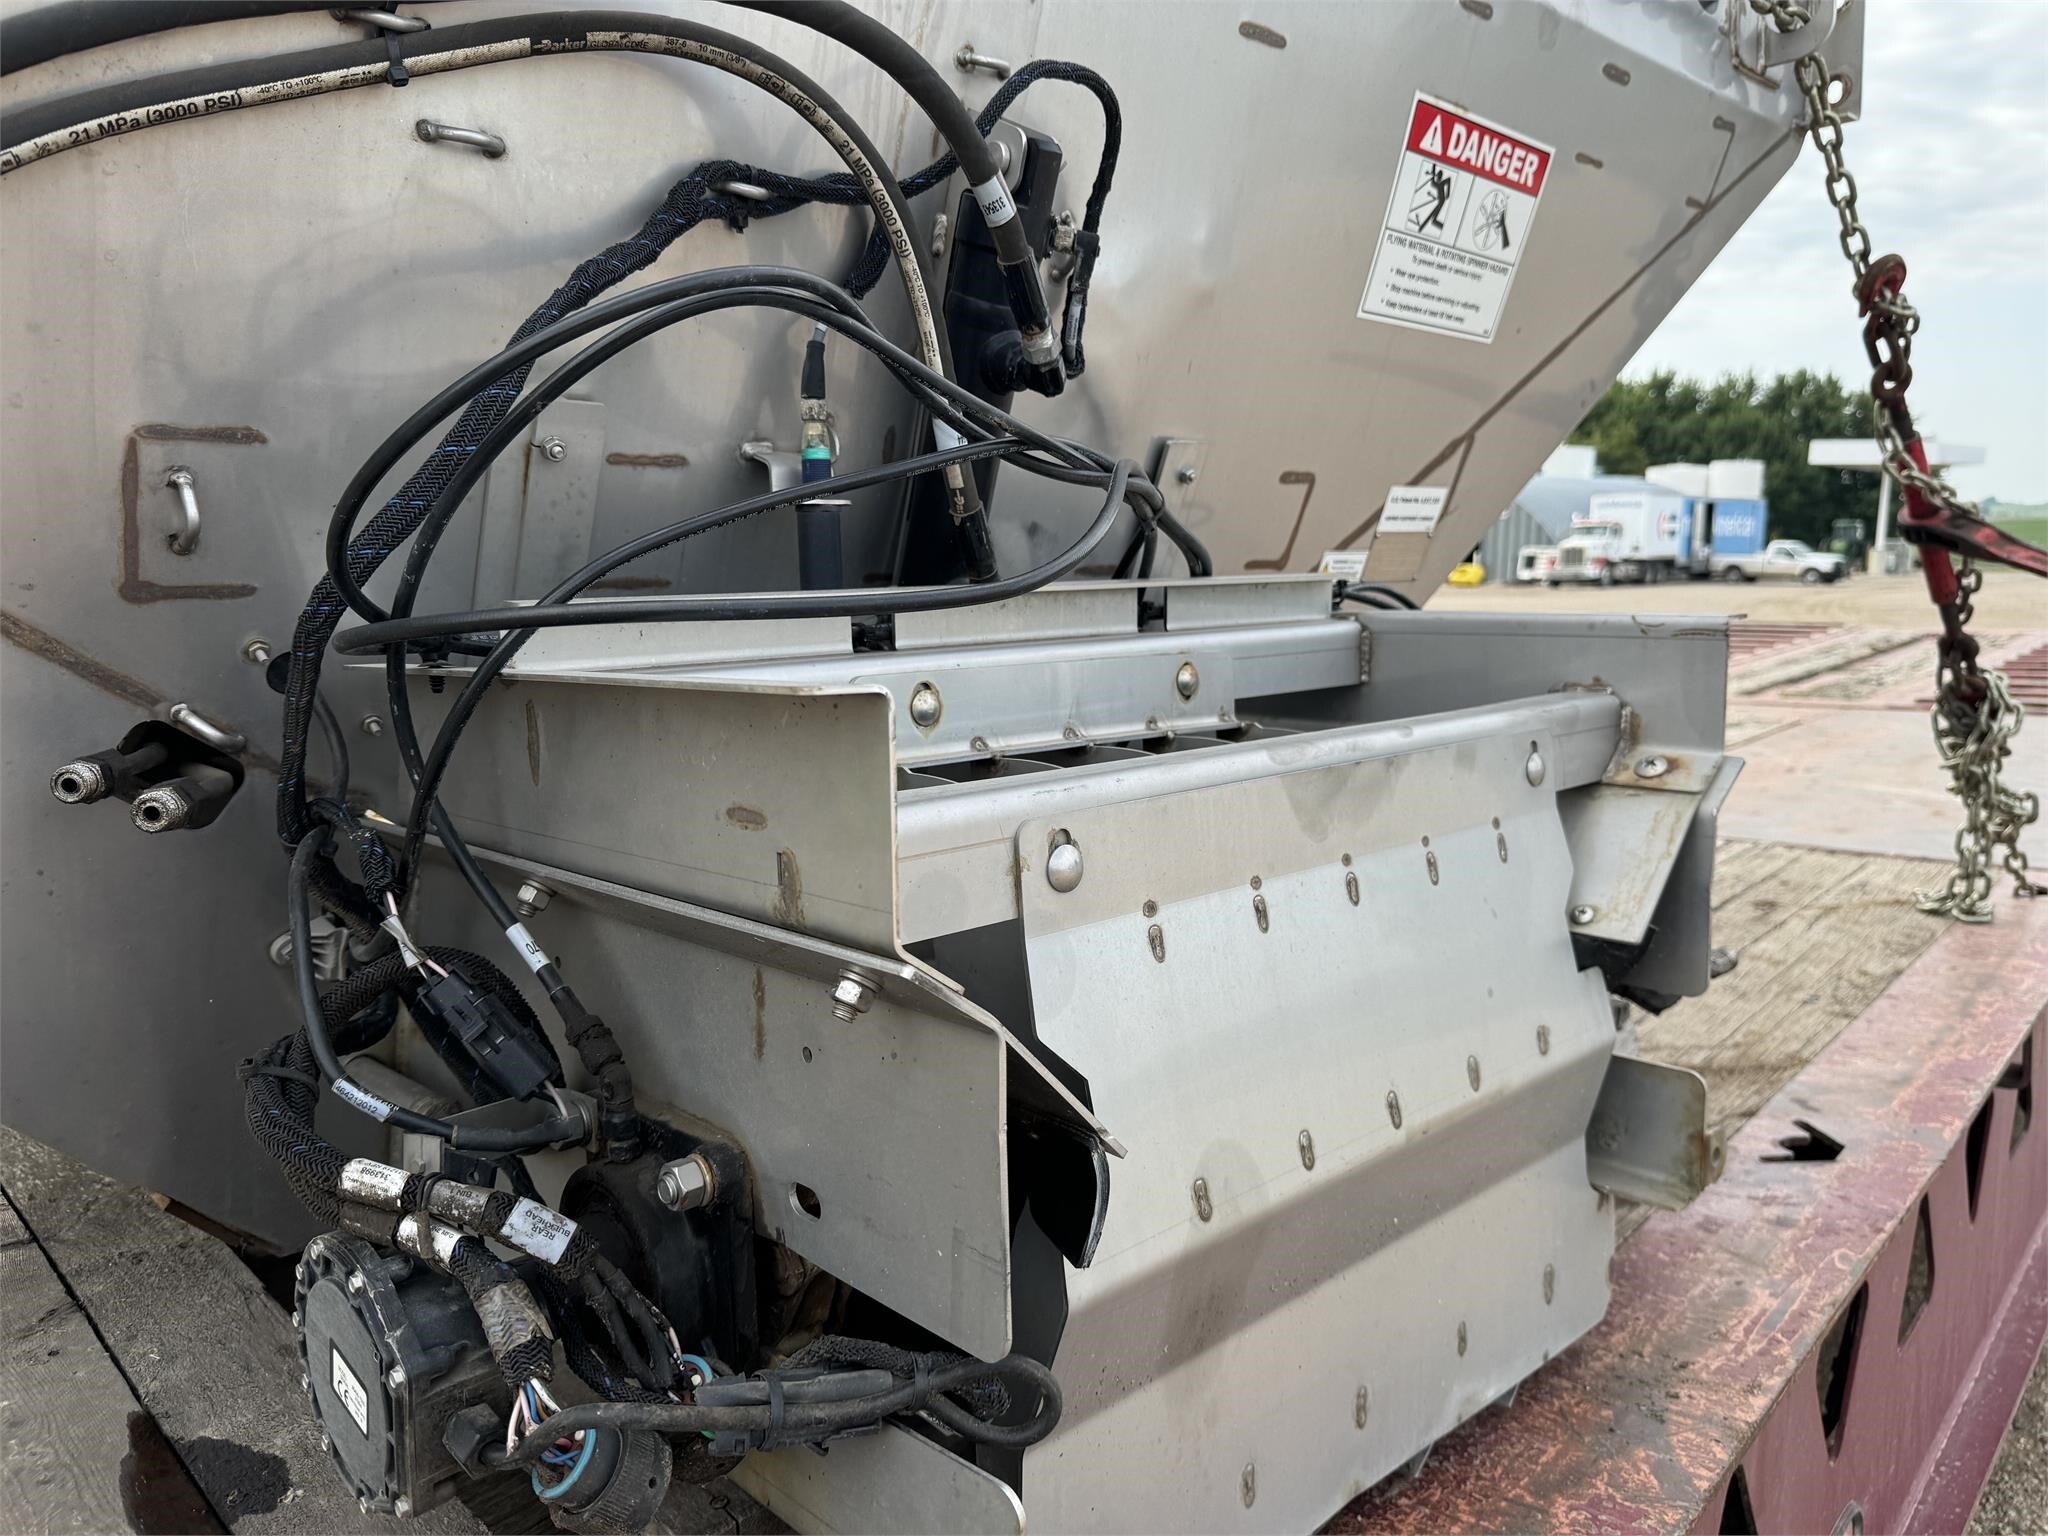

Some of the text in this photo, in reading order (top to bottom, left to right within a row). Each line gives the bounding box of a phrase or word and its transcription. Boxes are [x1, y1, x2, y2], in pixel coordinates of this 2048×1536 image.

[709, 48, 725, 58] mm
[70, 93, 242, 144] 21 MPa (3000 PSI)
[1447, 123, 1539, 188] DANGER
[839, 140, 912, 258] 21 MPa (3000 PSI)
[917, 284, 924, 294] TO
[335, 1084, 378, 1115] 464212012
[456, 1189, 472, 1198] BIN
[524, 1209, 571, 1238] BULKHEAD
[531, 1224, 556, 1241] REAR
